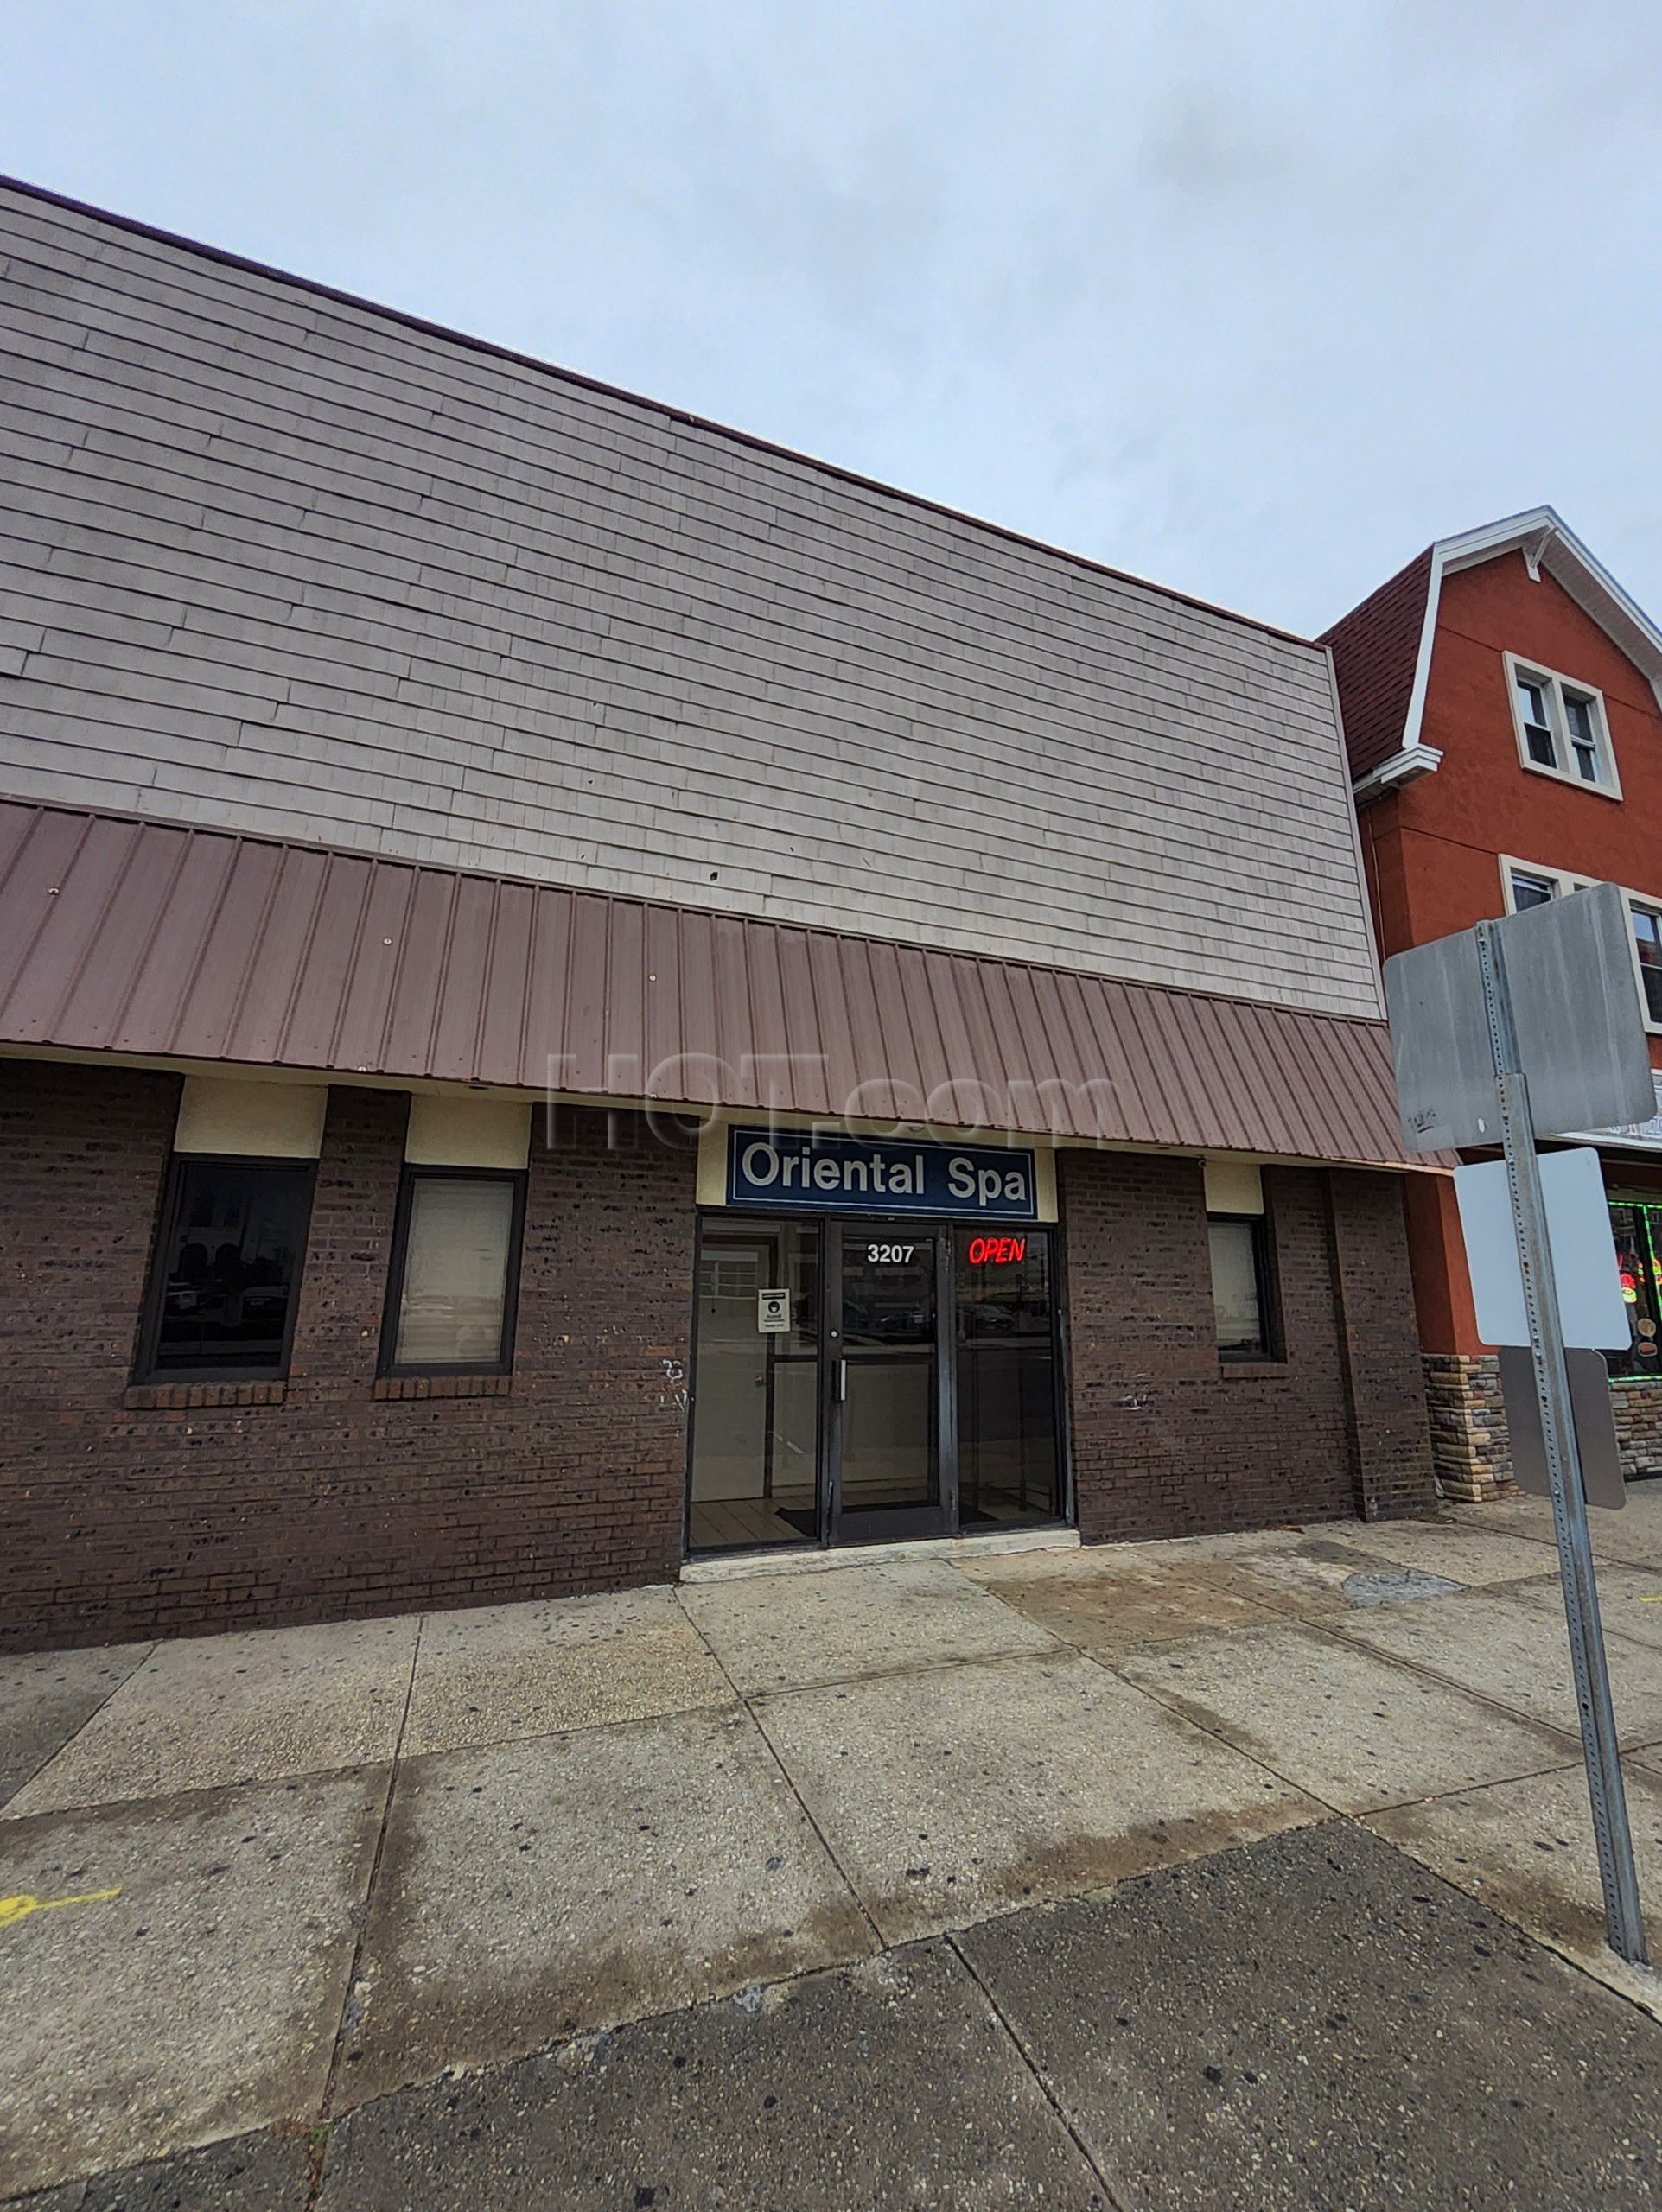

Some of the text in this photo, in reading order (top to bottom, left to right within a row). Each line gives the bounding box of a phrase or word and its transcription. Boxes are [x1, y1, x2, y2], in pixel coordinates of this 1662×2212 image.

[742, 1141, 1027, 1206] Oriental Spa
[867, 1243, 914, 1264] 3207
[968, 1236, 1026, 1264] OPEN
